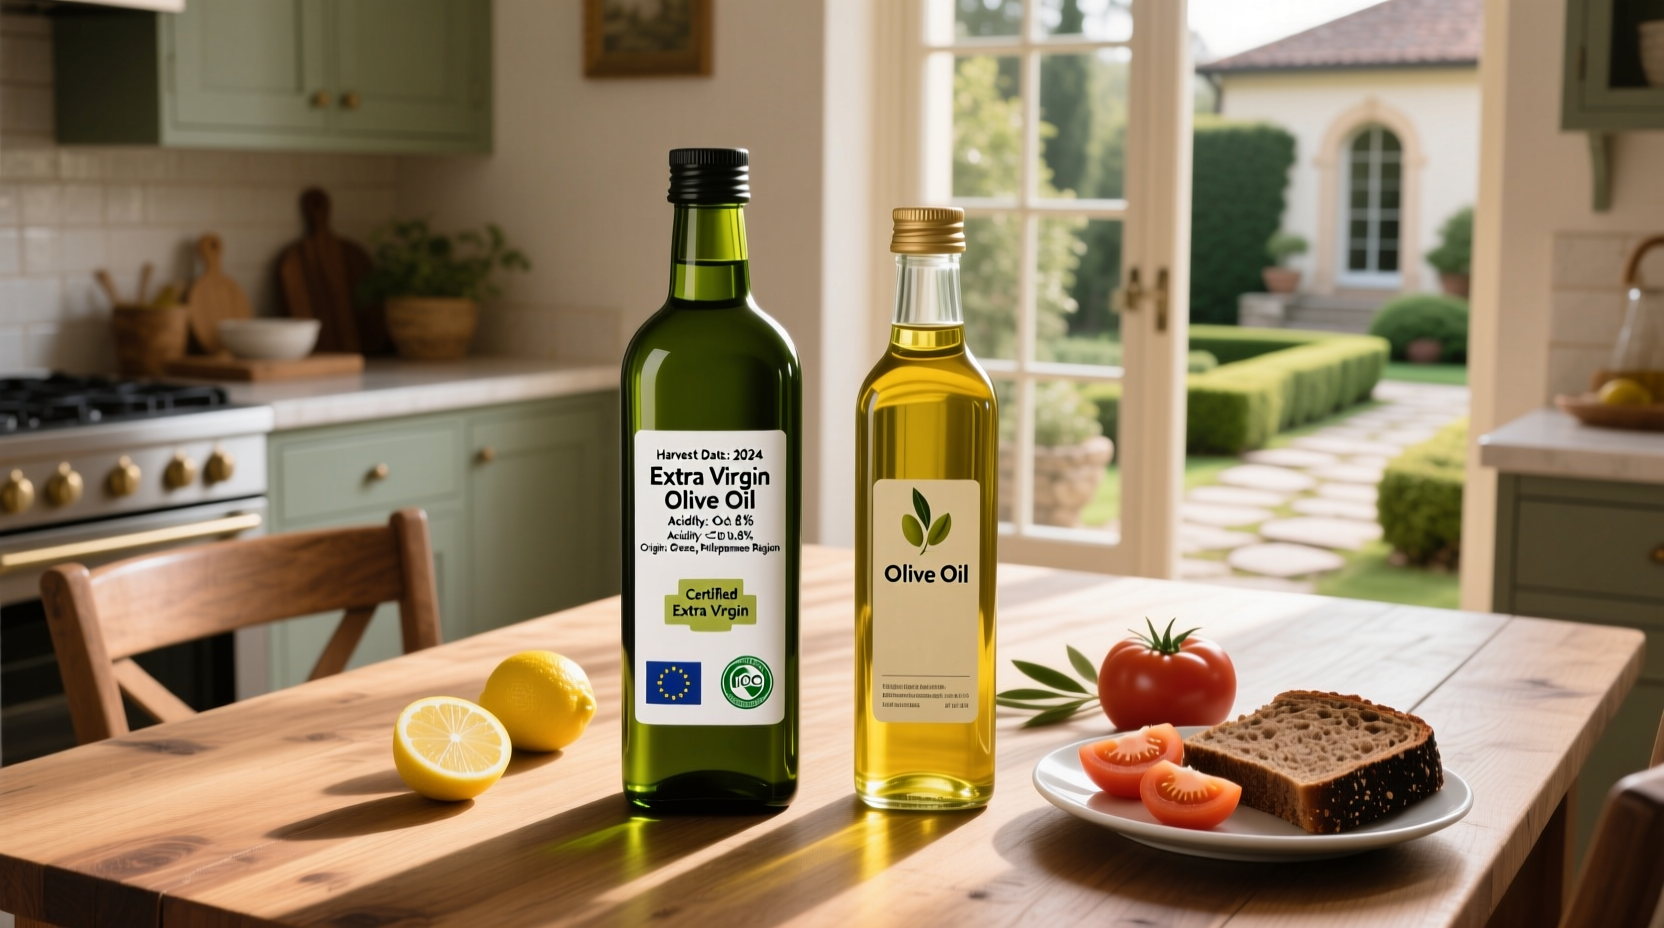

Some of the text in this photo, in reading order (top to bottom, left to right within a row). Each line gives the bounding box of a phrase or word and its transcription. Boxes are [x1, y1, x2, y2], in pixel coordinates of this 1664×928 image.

[656, 449, 699, 460] Harvest
[733, 449, 763, 460] 2024
[650, 466, 770, 490] Extra Virgin
[665, 490, 755, 509] Olive Oil
[884, 563, 968, 583] Olive Oil
[673, 604, 707, 617] Extra
